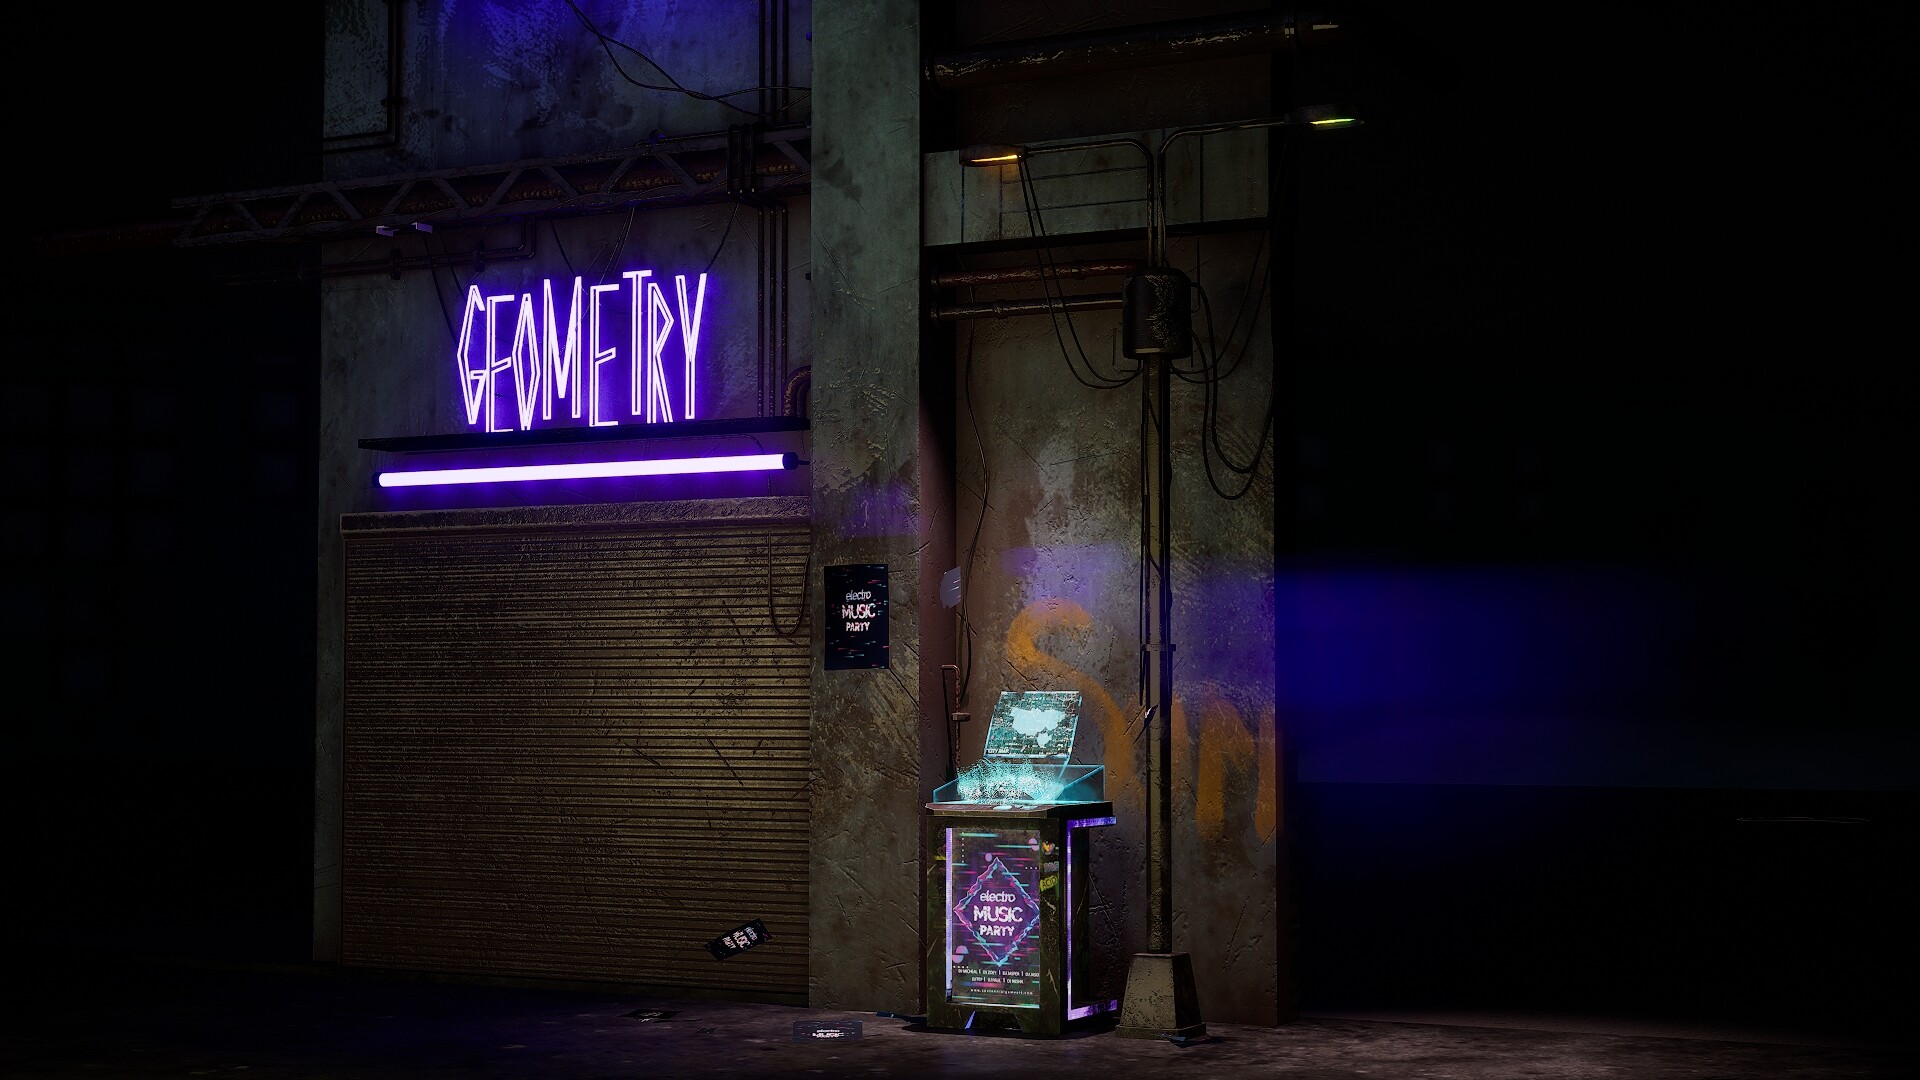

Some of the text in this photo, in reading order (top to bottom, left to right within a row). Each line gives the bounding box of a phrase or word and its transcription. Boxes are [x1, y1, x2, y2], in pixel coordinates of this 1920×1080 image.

[457, 270, 707, 432] GEOMETRY
[846, 589, 872, 601] electro
[842, 603, 876, 619] MUSIC
[845, 621, 870, 632] PARTY
[980, 890, 1016, 903] electro
[973, 905, 1023, 923] MUSIC
[979, 924, 1015, 936] PARTY
